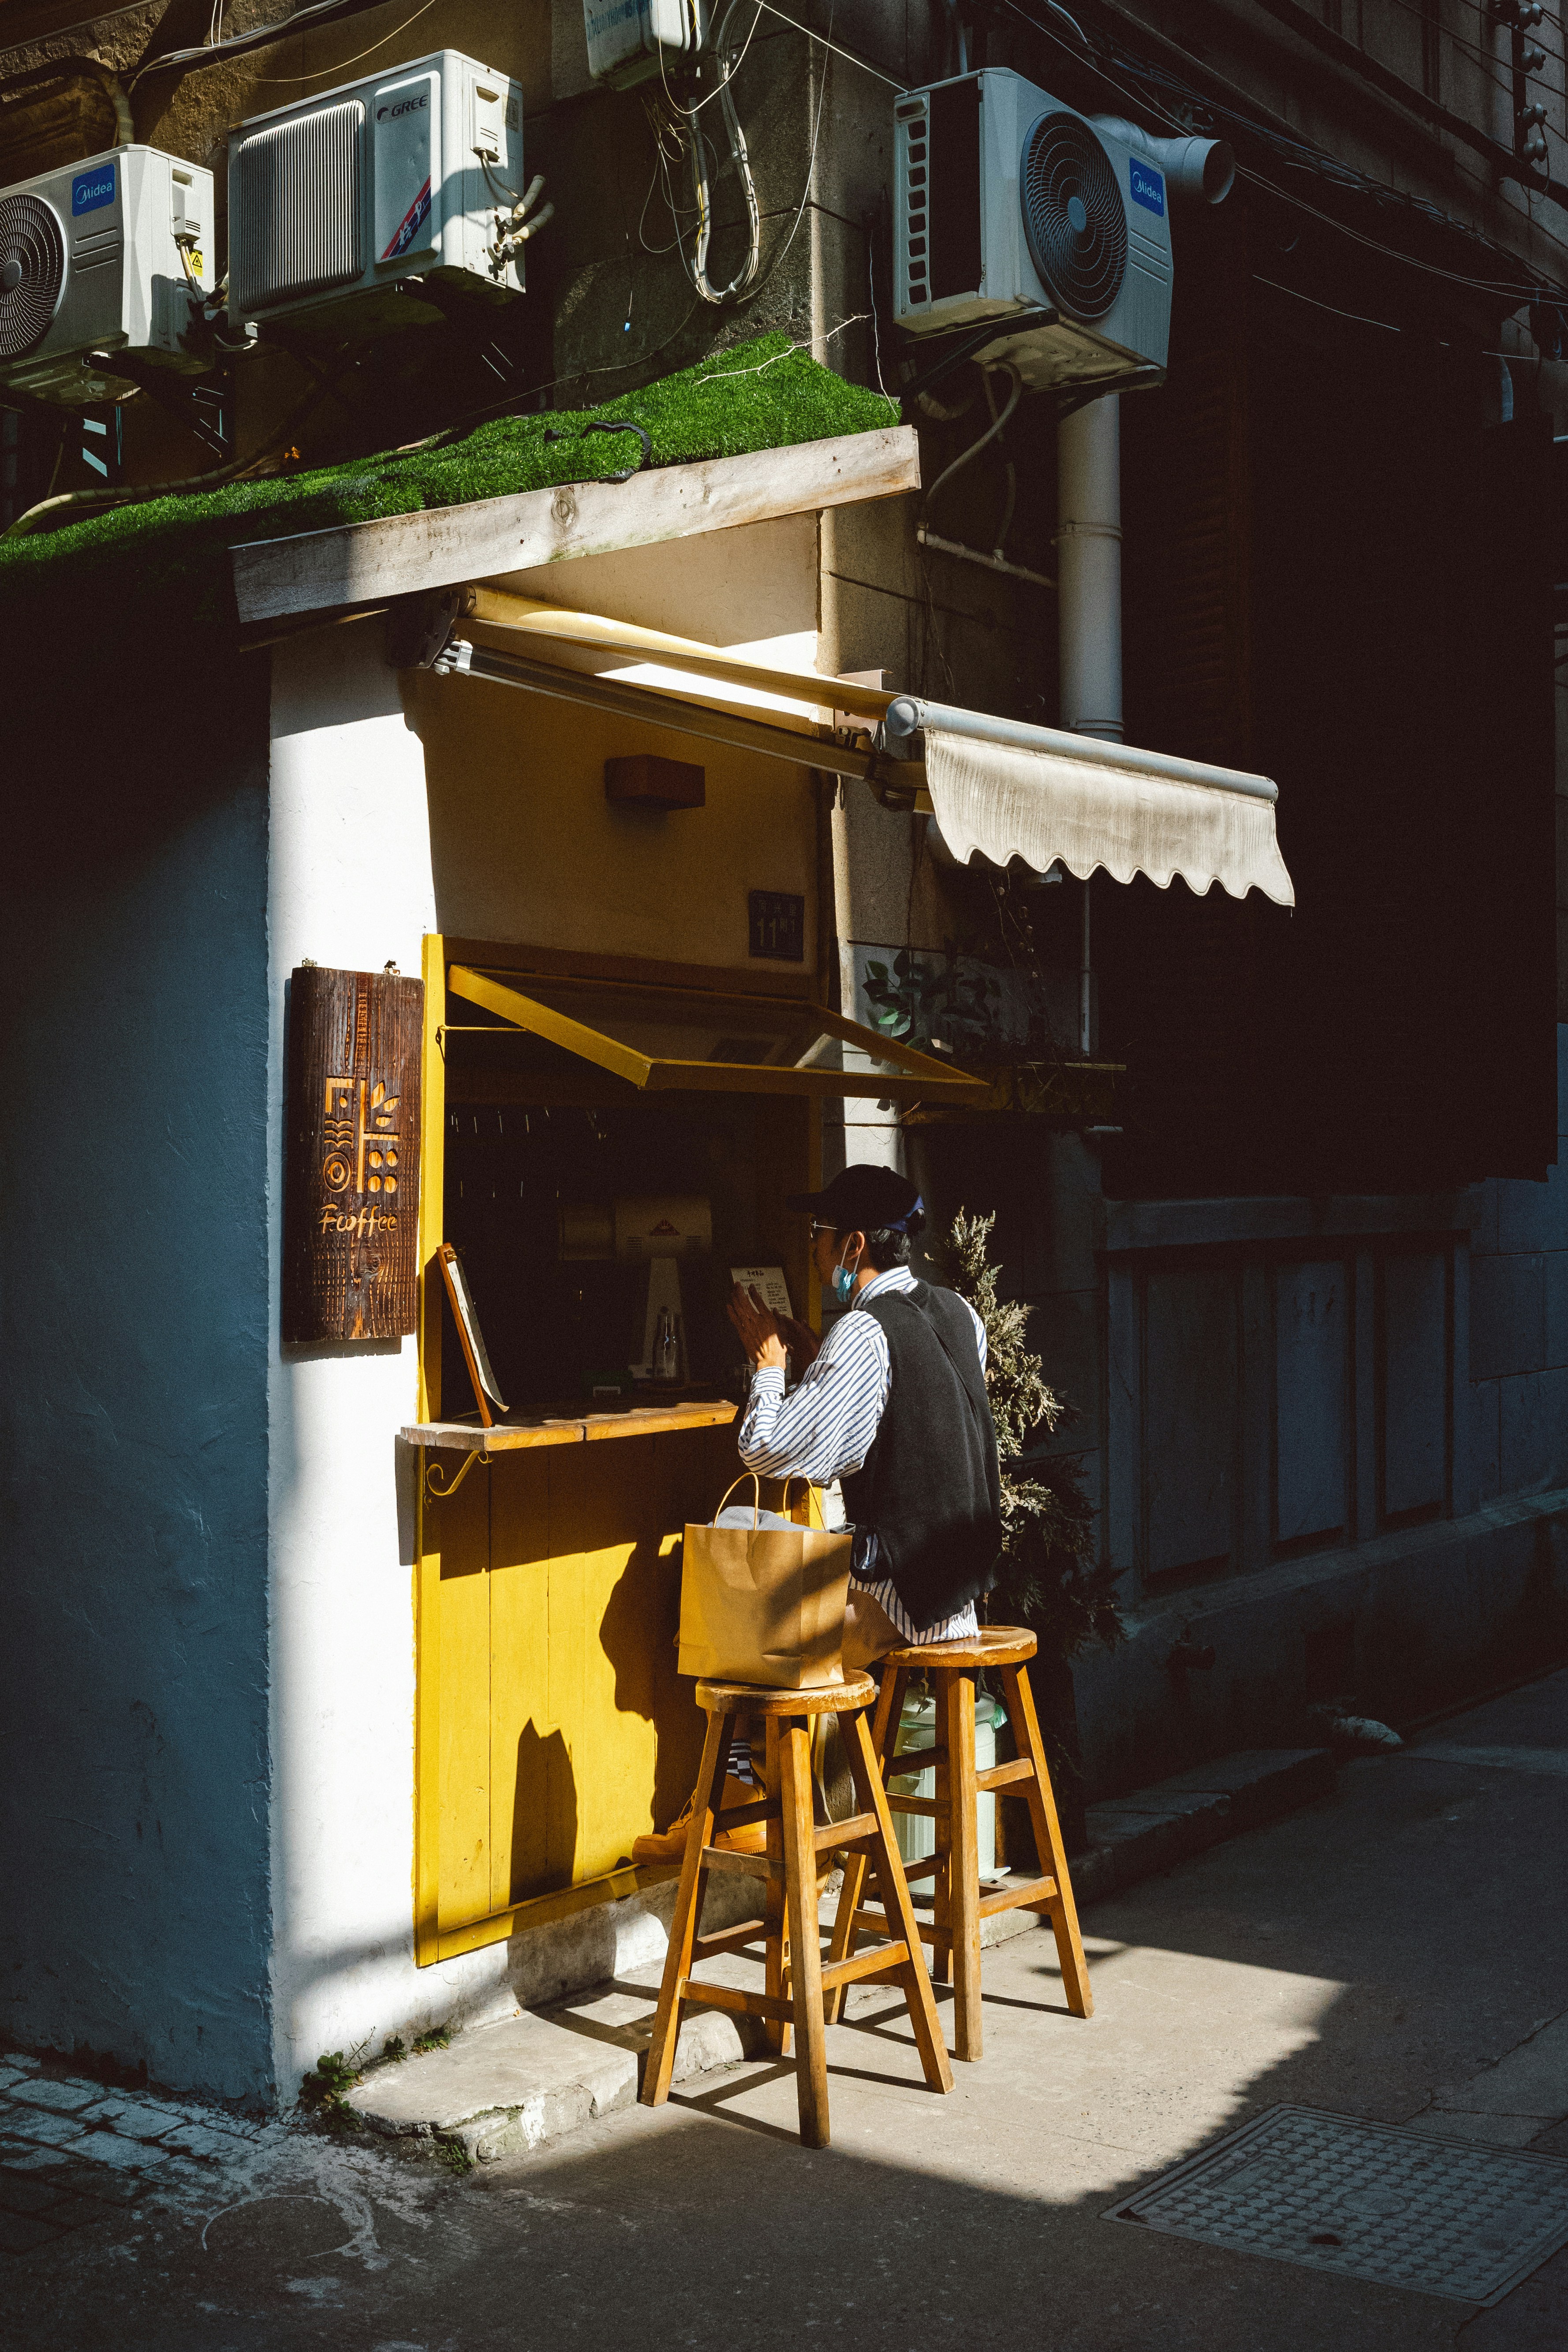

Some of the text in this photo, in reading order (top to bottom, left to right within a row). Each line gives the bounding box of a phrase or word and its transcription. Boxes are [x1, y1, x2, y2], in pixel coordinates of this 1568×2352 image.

[392, 94, 428, 117] GREE
[75, 182, 112, 205] Midea
[1132, 171, 1161, 204] Midea
